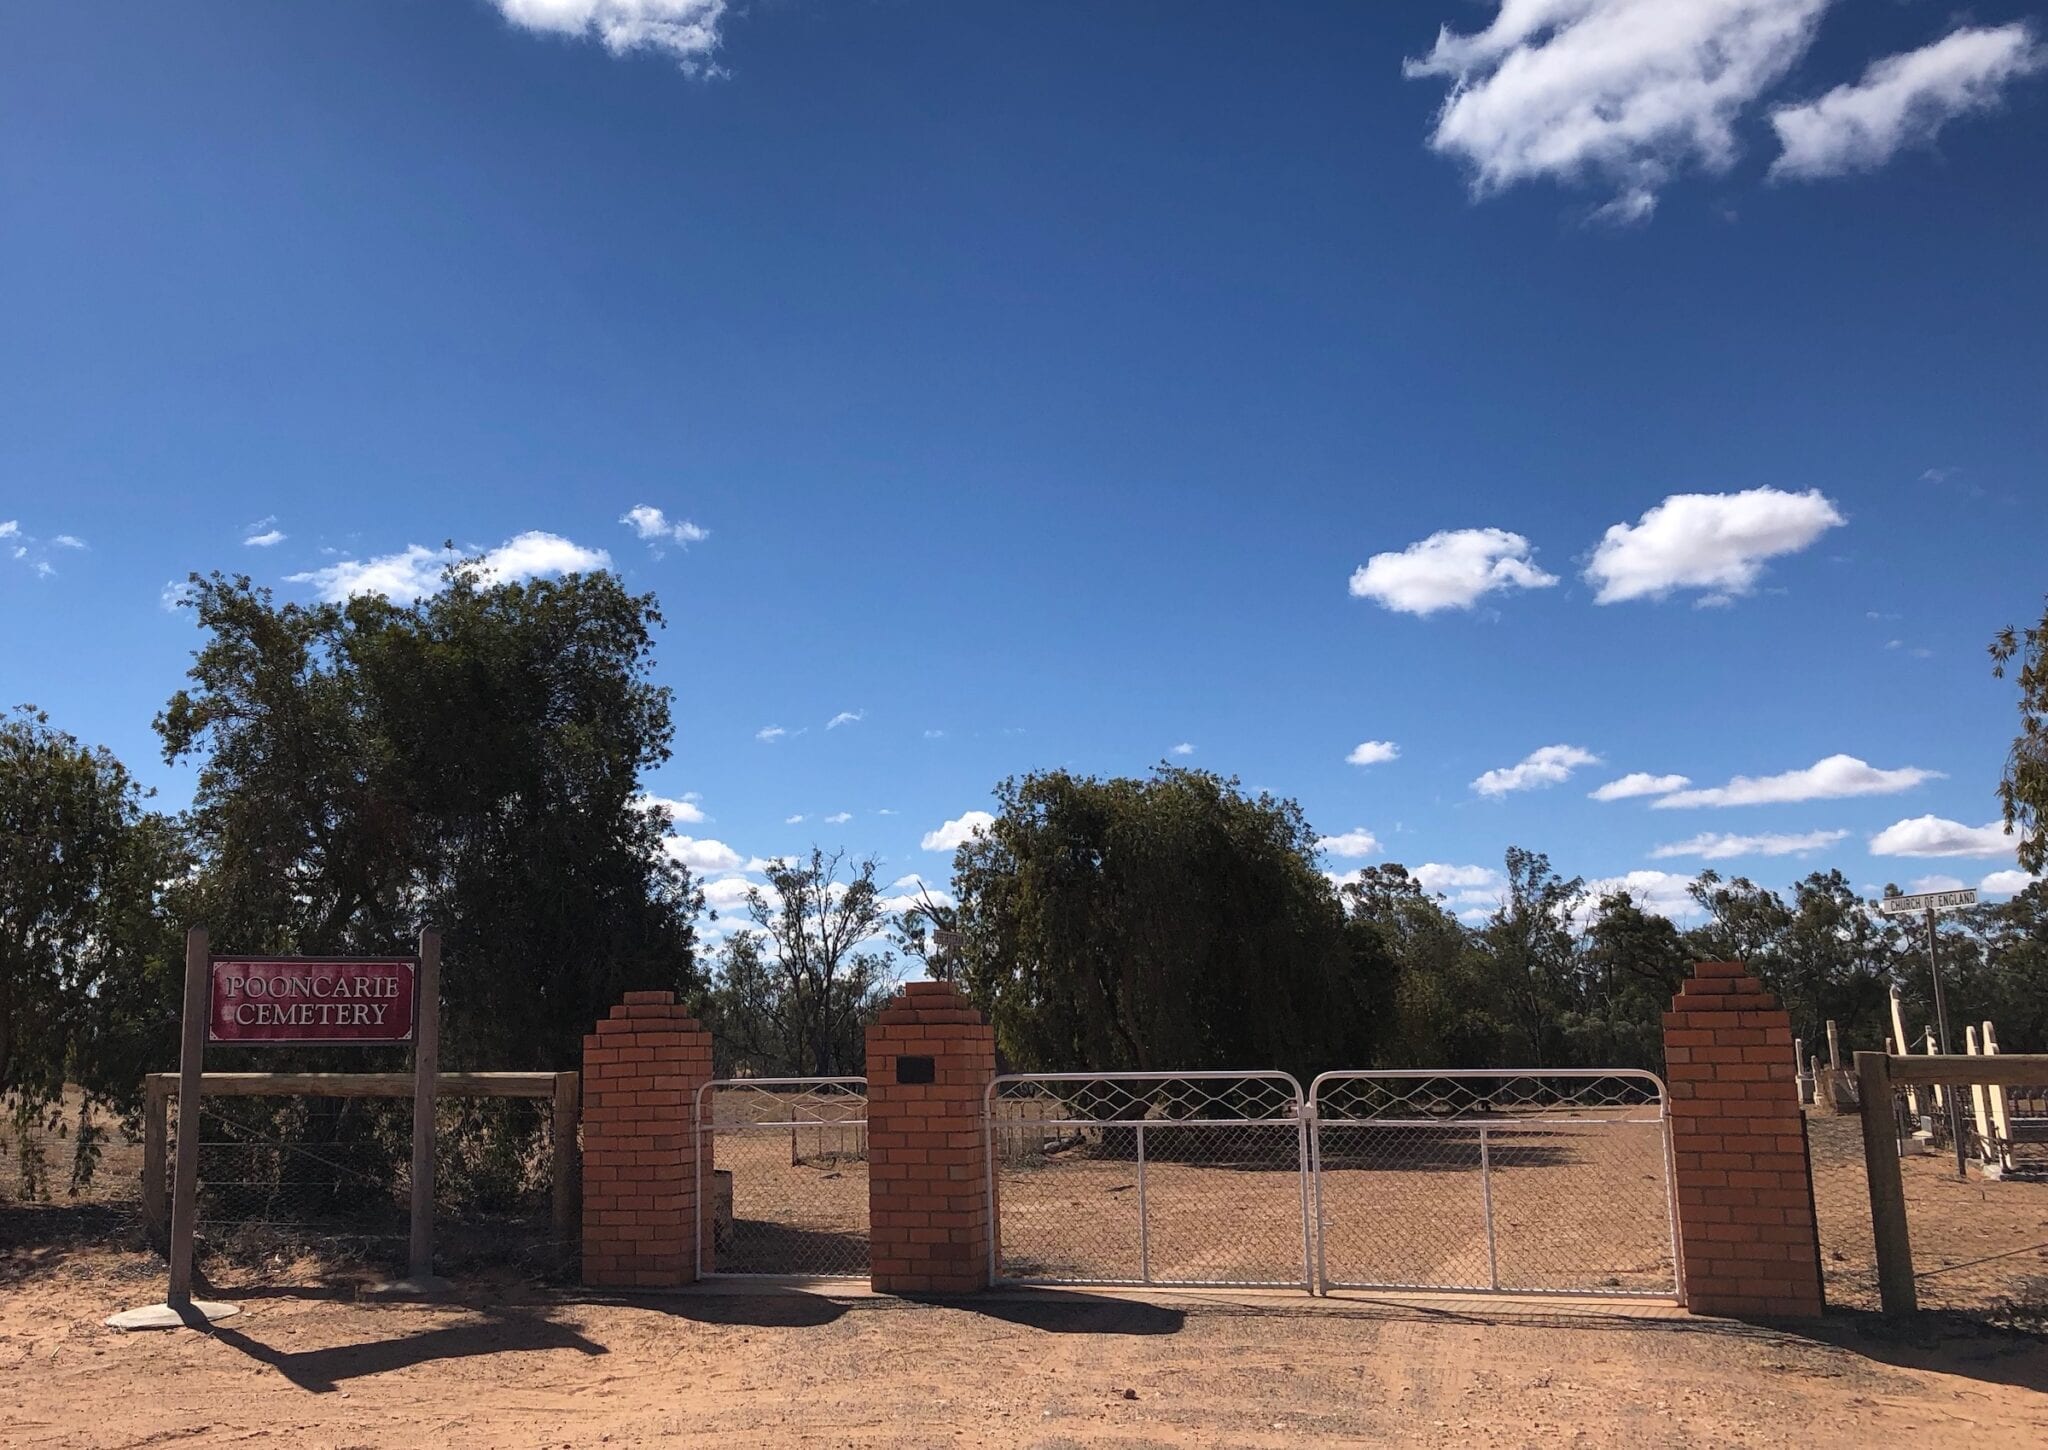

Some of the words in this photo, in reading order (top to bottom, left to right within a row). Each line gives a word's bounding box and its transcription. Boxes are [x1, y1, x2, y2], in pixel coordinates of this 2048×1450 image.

[1890, 897, 1921, 911] CHURCH
[1924, 896, 1934, 907] OF
[1938, 892, 1975, 907] ENGLAND
[227, 976, 400, 998] POONCARIE
[235, 1003, 389, 1025] CEMETERY
